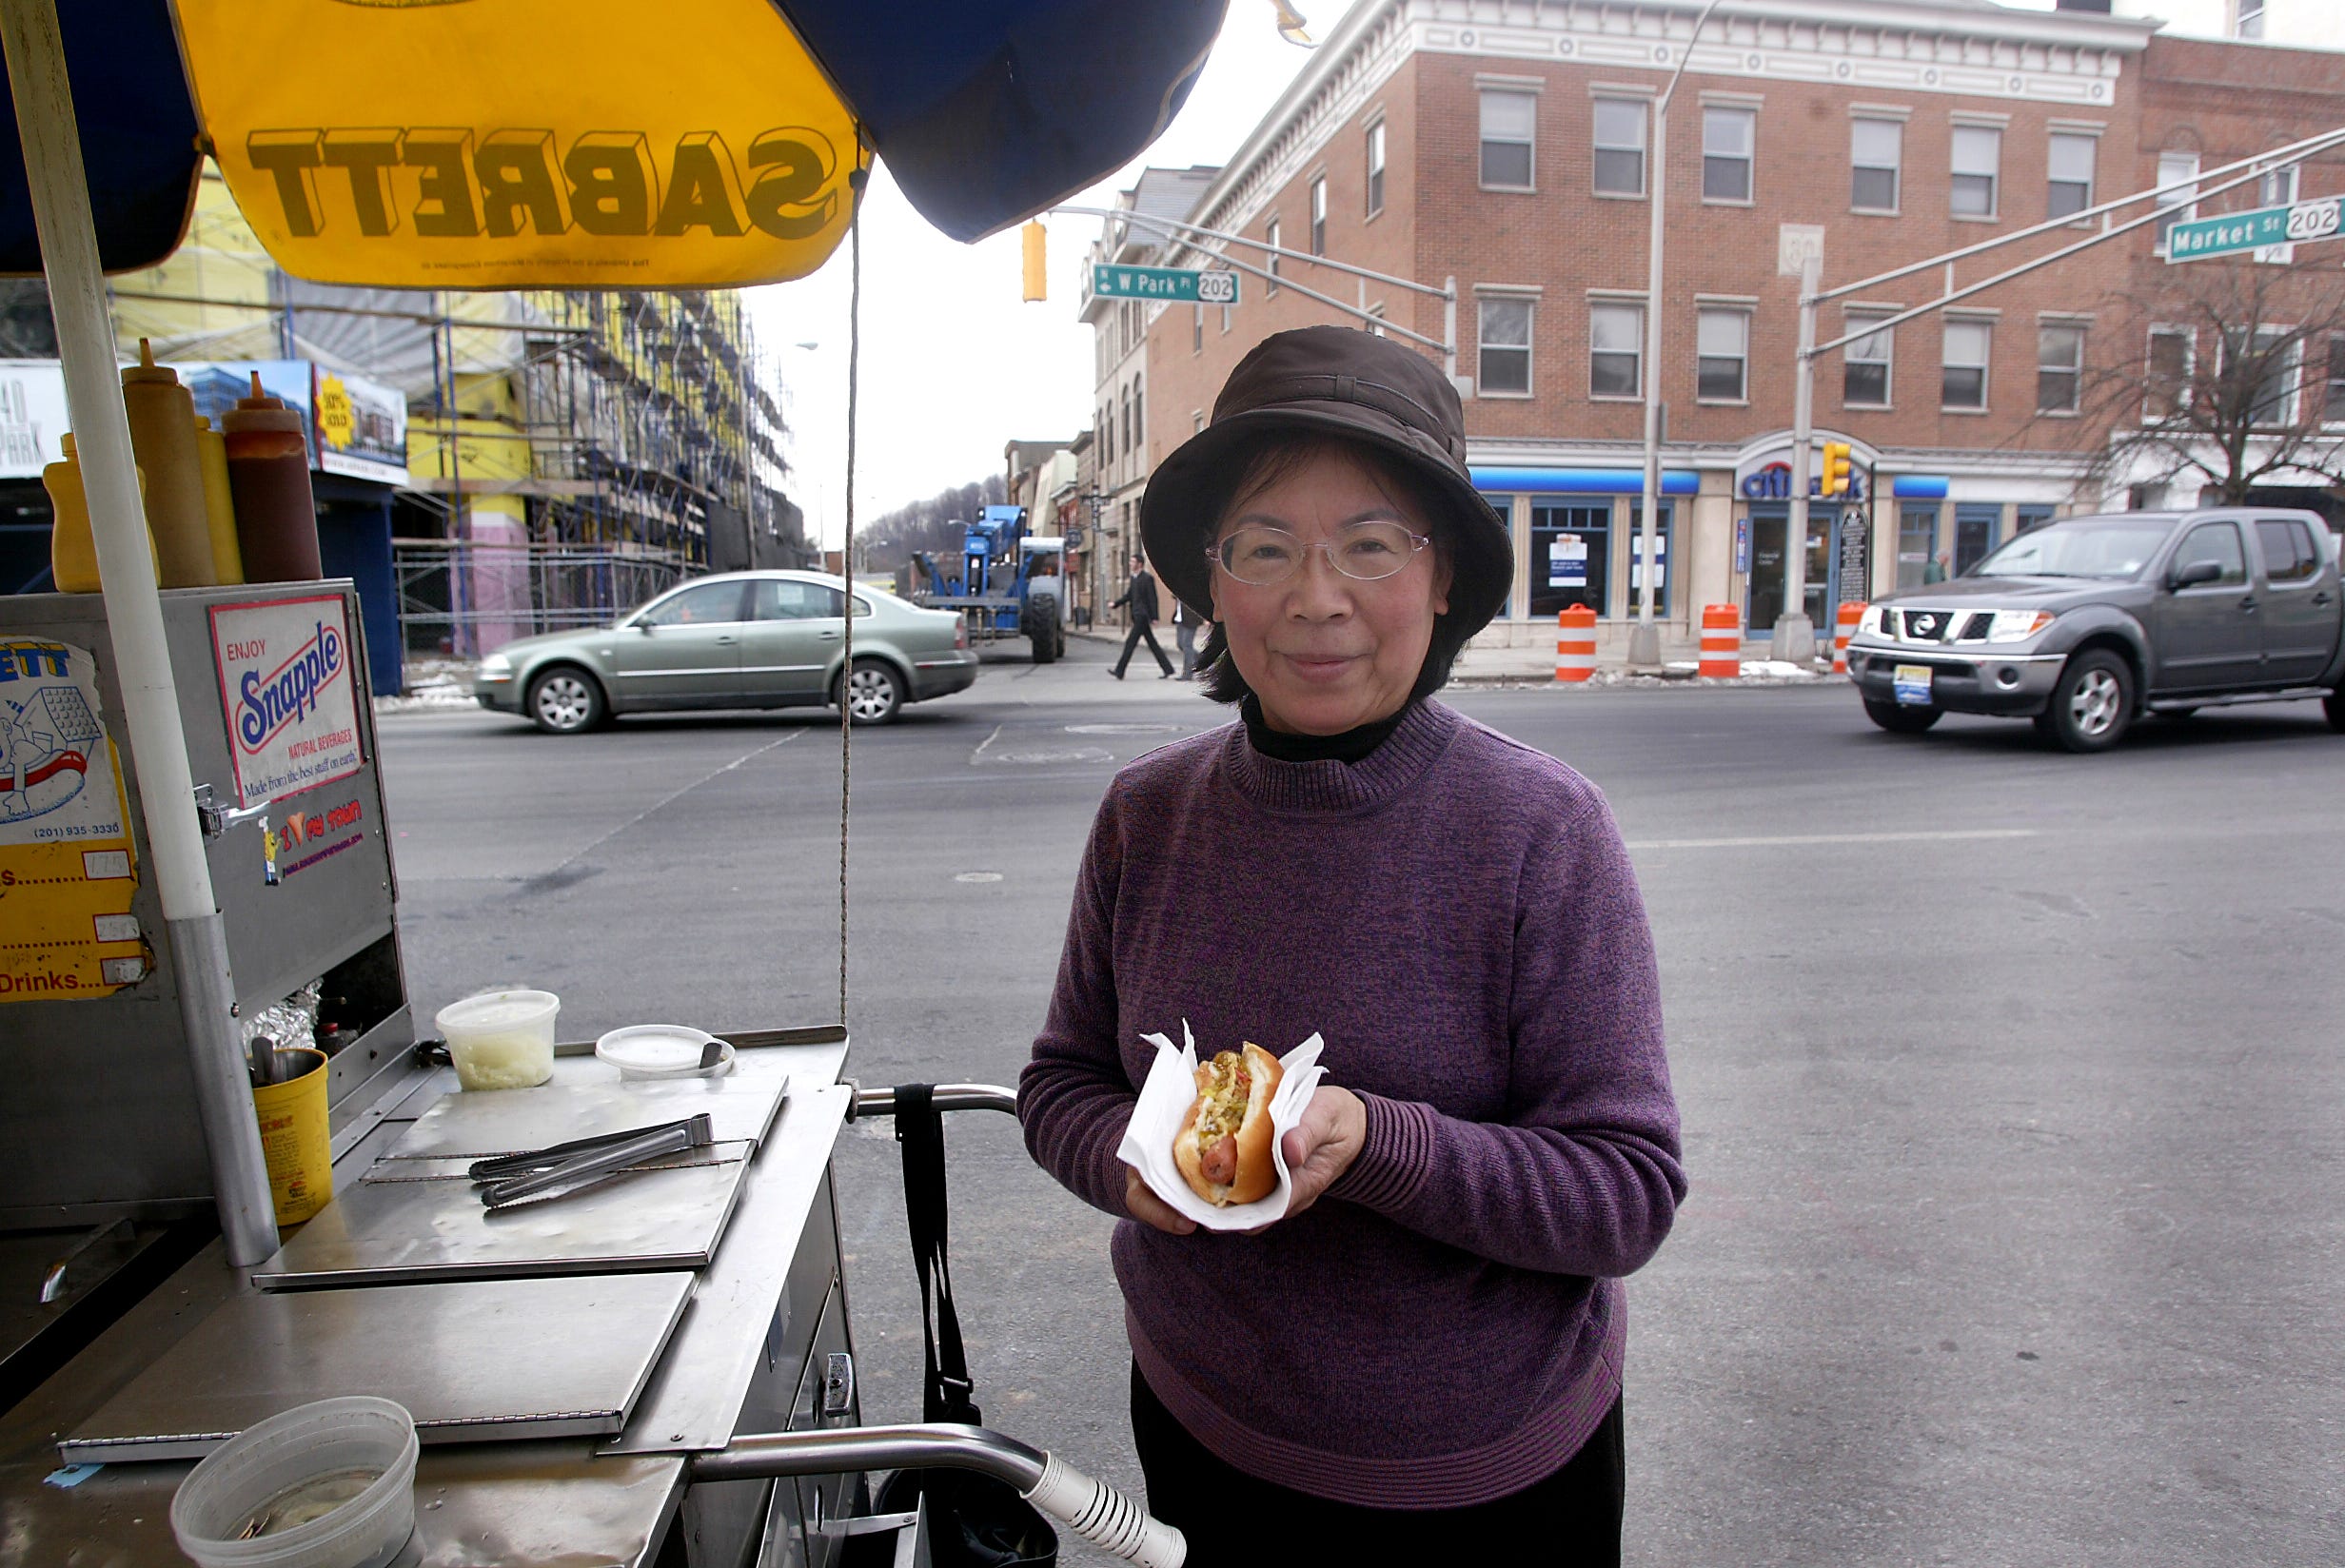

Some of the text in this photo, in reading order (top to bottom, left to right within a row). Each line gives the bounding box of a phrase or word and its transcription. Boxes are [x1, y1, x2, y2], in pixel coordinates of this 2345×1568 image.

[2175, 208, 2335, 253] Market St 202
[1118, 273, 1132, 291] W
[1137, 274, 1176, 295] Park
[1201, 278, 1231, 296] 202
[227, 639, 266, 661] ENJOY
[241, 620, 338, 745] Snapple
[288, 728, 352, 760] NATURAL BEVERAGES
[245, 779, 267, 799] Made
[268, 774, 286, 791] from
[287, 770, 299, 784] the
[299, 765, 314, 779] best
[34, 826, 64, 839] (201)
